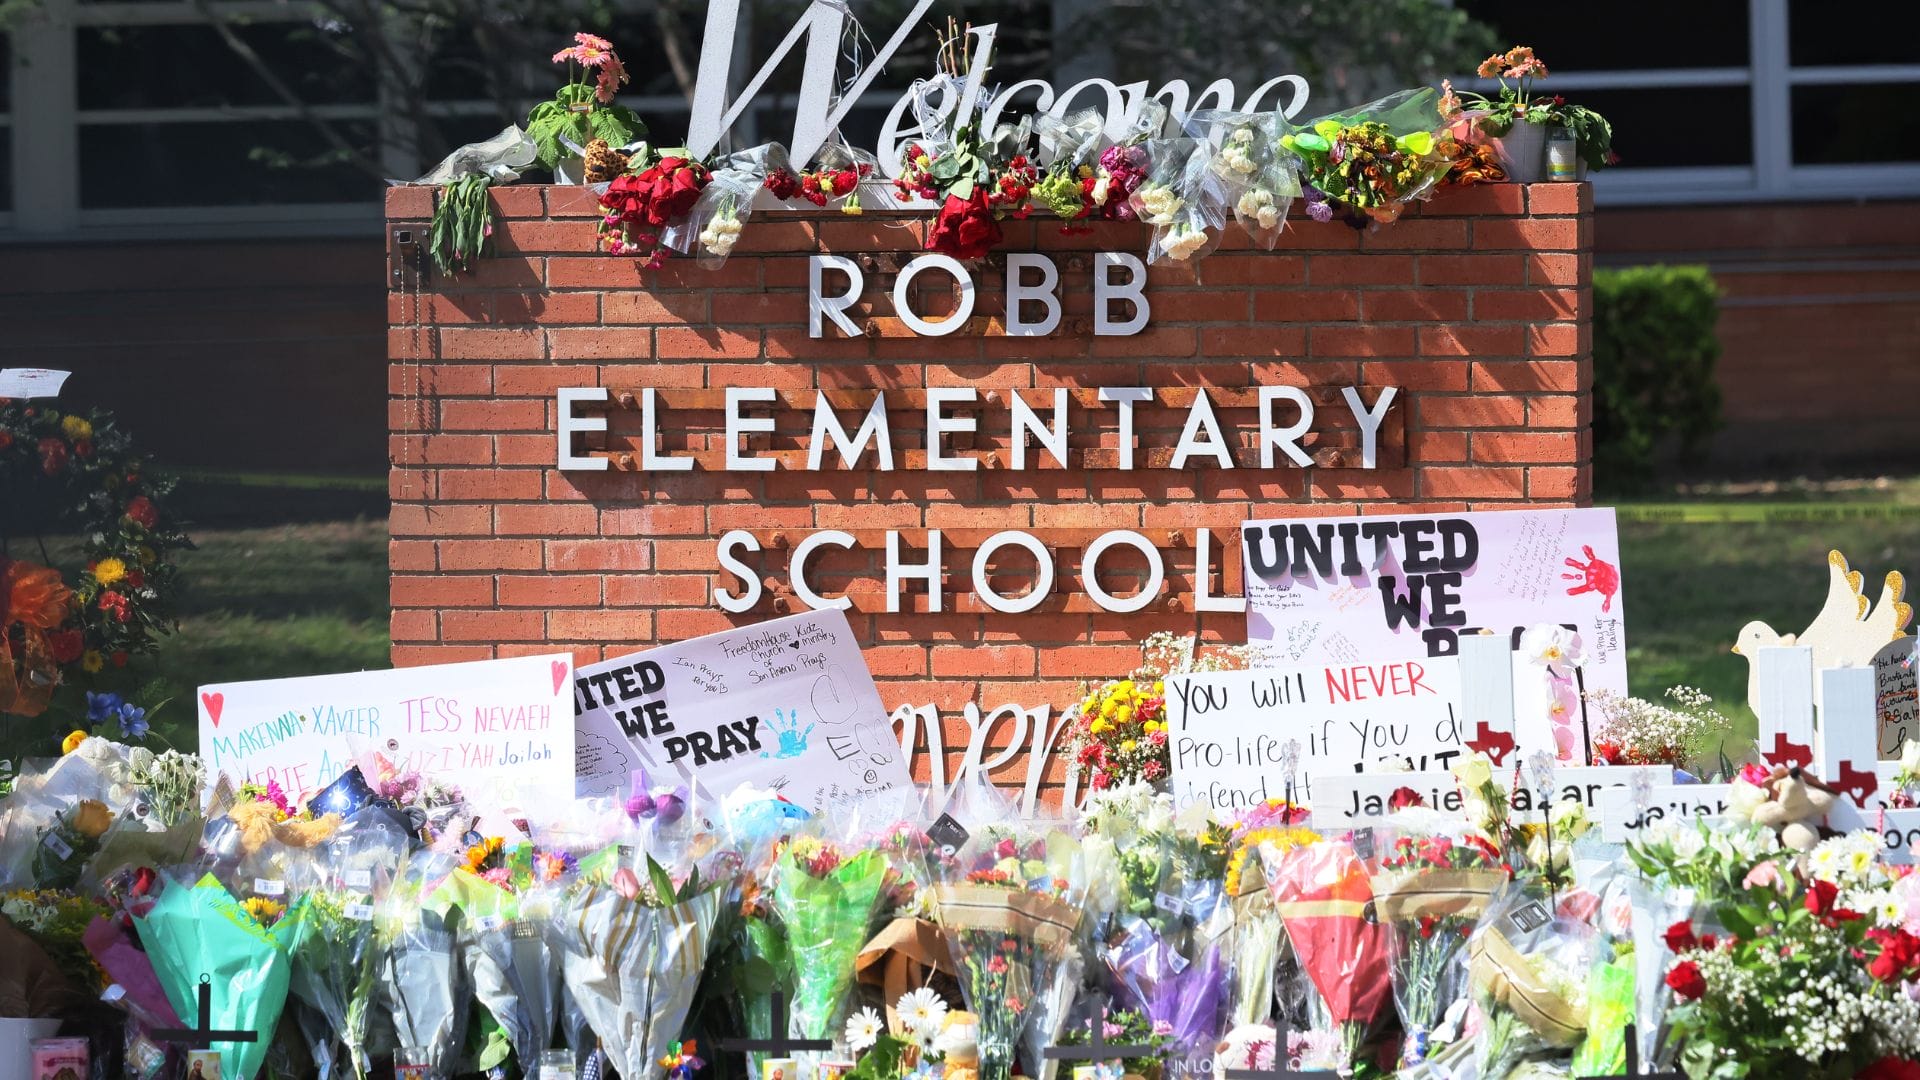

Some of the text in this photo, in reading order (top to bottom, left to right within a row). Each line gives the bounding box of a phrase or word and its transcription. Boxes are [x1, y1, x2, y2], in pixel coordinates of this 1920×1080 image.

[688, 0, 1310, 179] Welcome
[810, 254, 1150, 338] ROBB
[557, 386, 1398, 472] ELEMENTARY
[713, 528, 1246, 614] SCHOOL
[1244, 519, 1478, 577] UNITED
[1378, 572, 1466, 629] WE
[751, 645, 785, 662] Church
[575, 660, 665, 716] ITED
[1325, 662, 1438, 704] NEVER
[212, 696, 550, 768] MAKENNA XAVIER TESS NEVAEH
[615, 699, 675, 739] WE
[663, 716, 762, 767] PRAY
[1310, 719, 1336, 757] if
[241, 762, 313, 794] ERIE
[1344, 788, 1463, 818] Jaie
